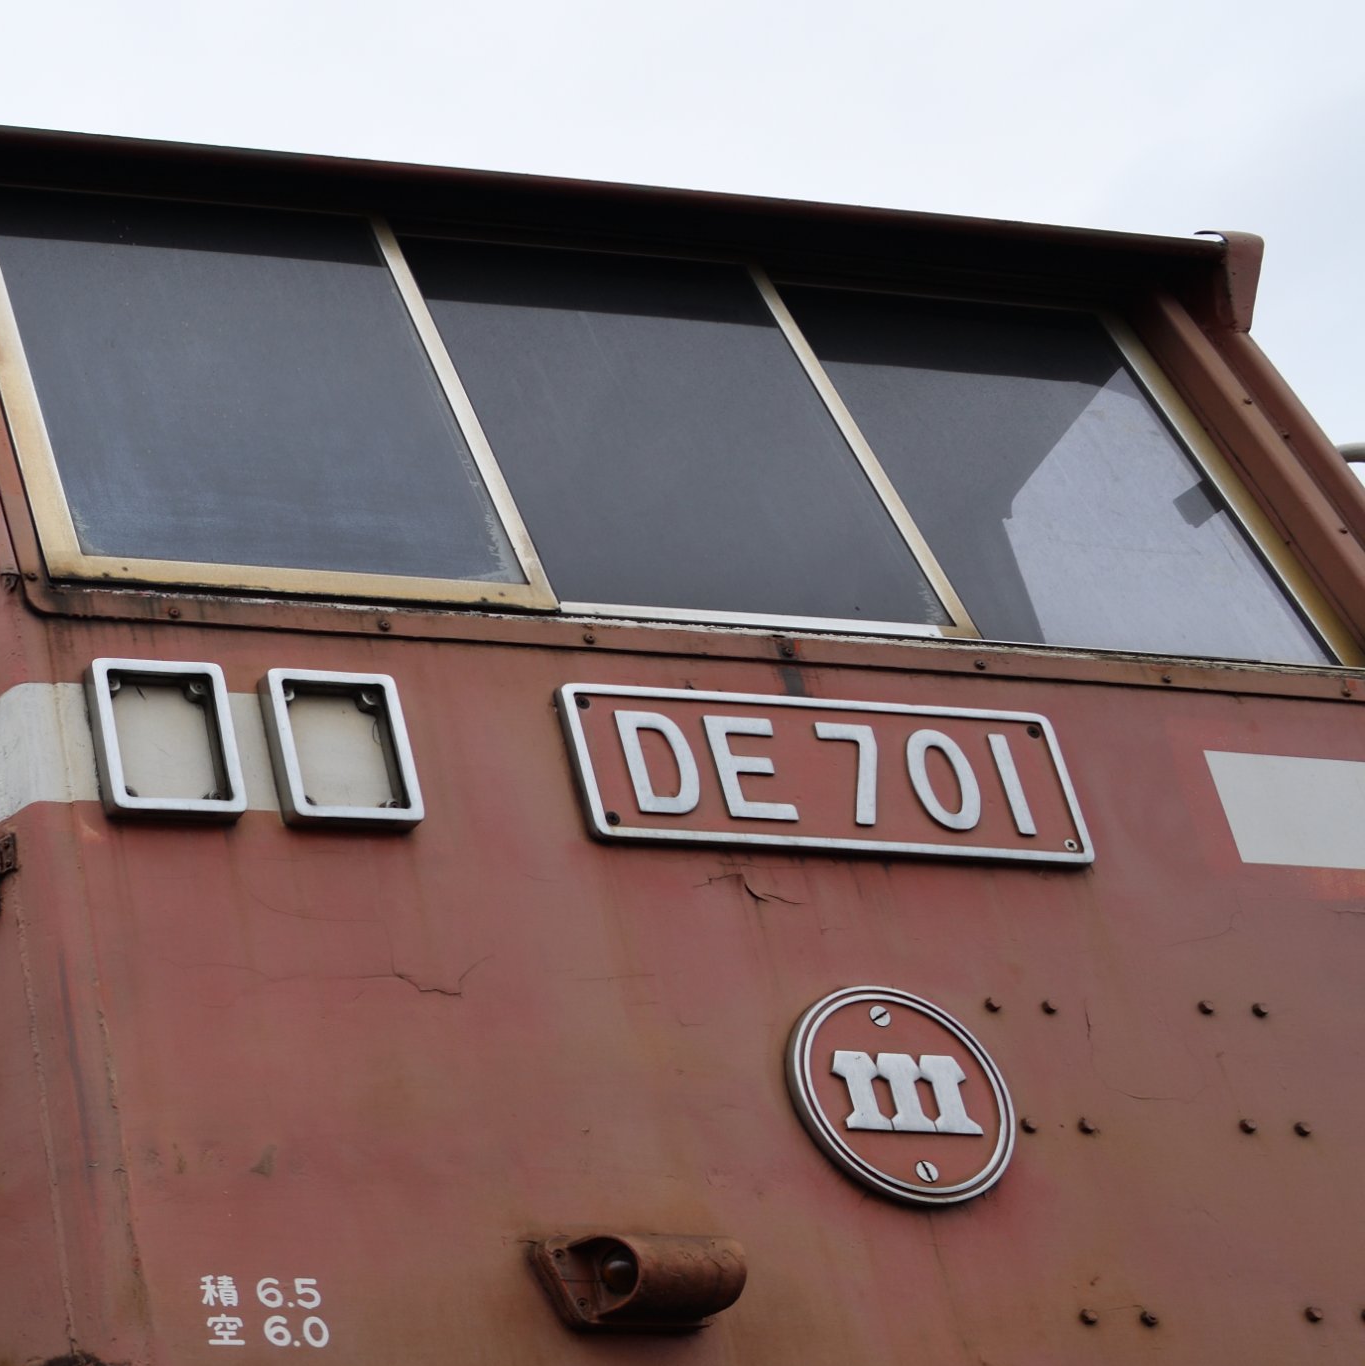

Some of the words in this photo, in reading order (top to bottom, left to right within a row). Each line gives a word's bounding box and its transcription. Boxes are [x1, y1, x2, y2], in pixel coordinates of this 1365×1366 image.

[199, 1274, 239, 1307] 積
[256, 1277, 322, 1310] 6.5
[206, 1313, 246, 1346] 空
[263, 1315, 330, 1348] 6.0
